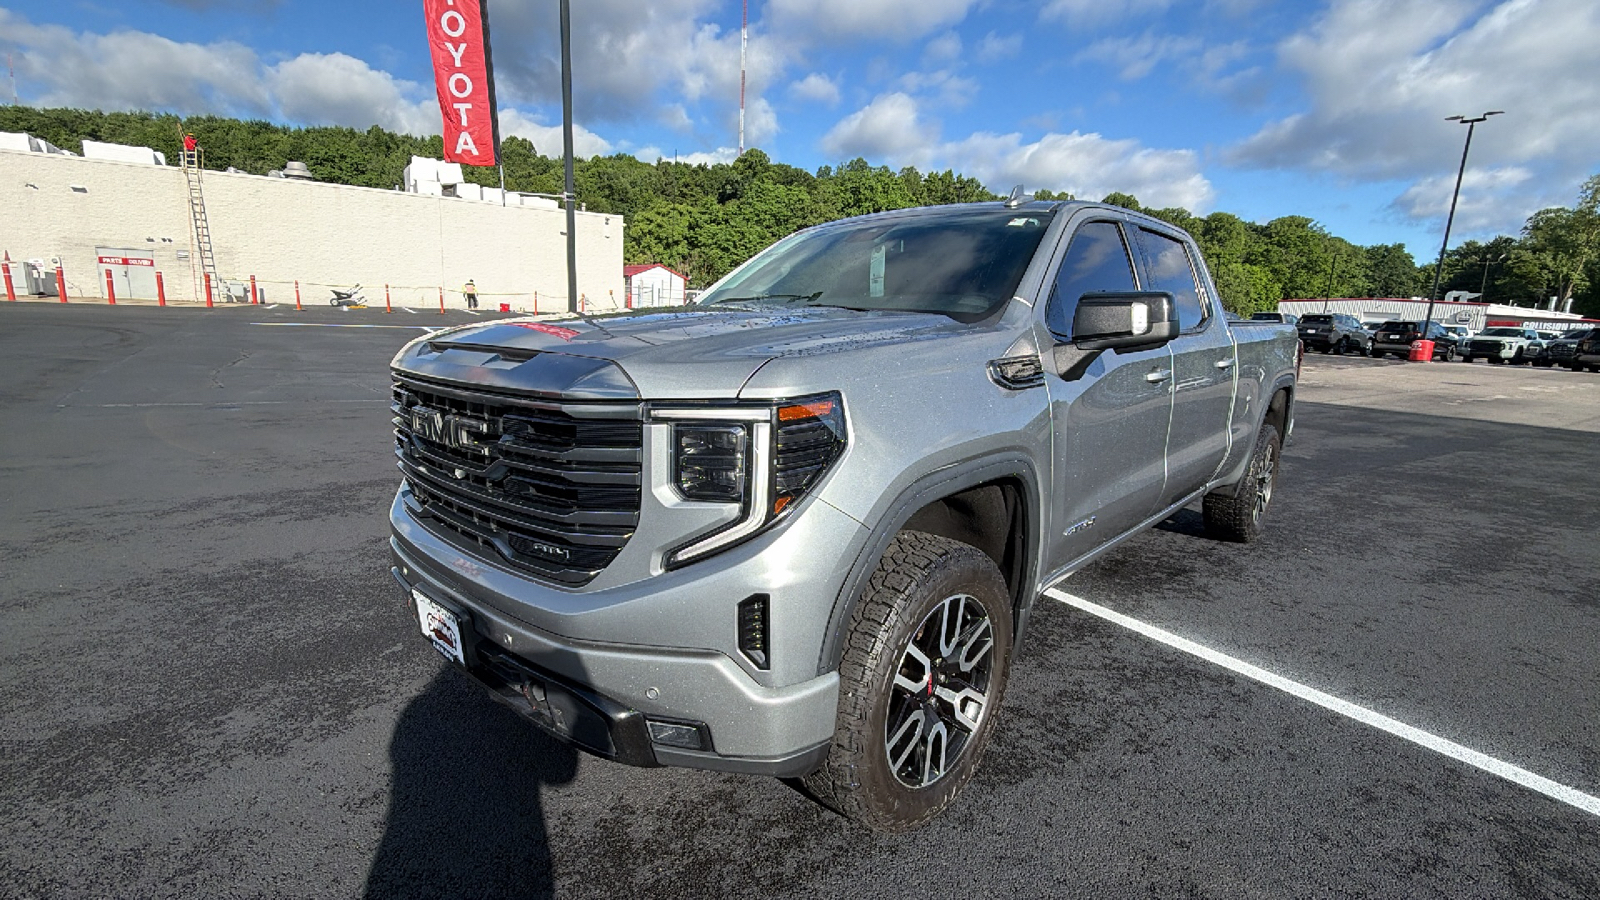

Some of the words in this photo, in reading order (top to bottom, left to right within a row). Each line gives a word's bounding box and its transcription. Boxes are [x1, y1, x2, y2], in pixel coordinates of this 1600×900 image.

[440, 0, 479, 155] OYOTA
[1522, 321, 1568, 331] COLLISION
[411, 405, 488, 456] GMC
